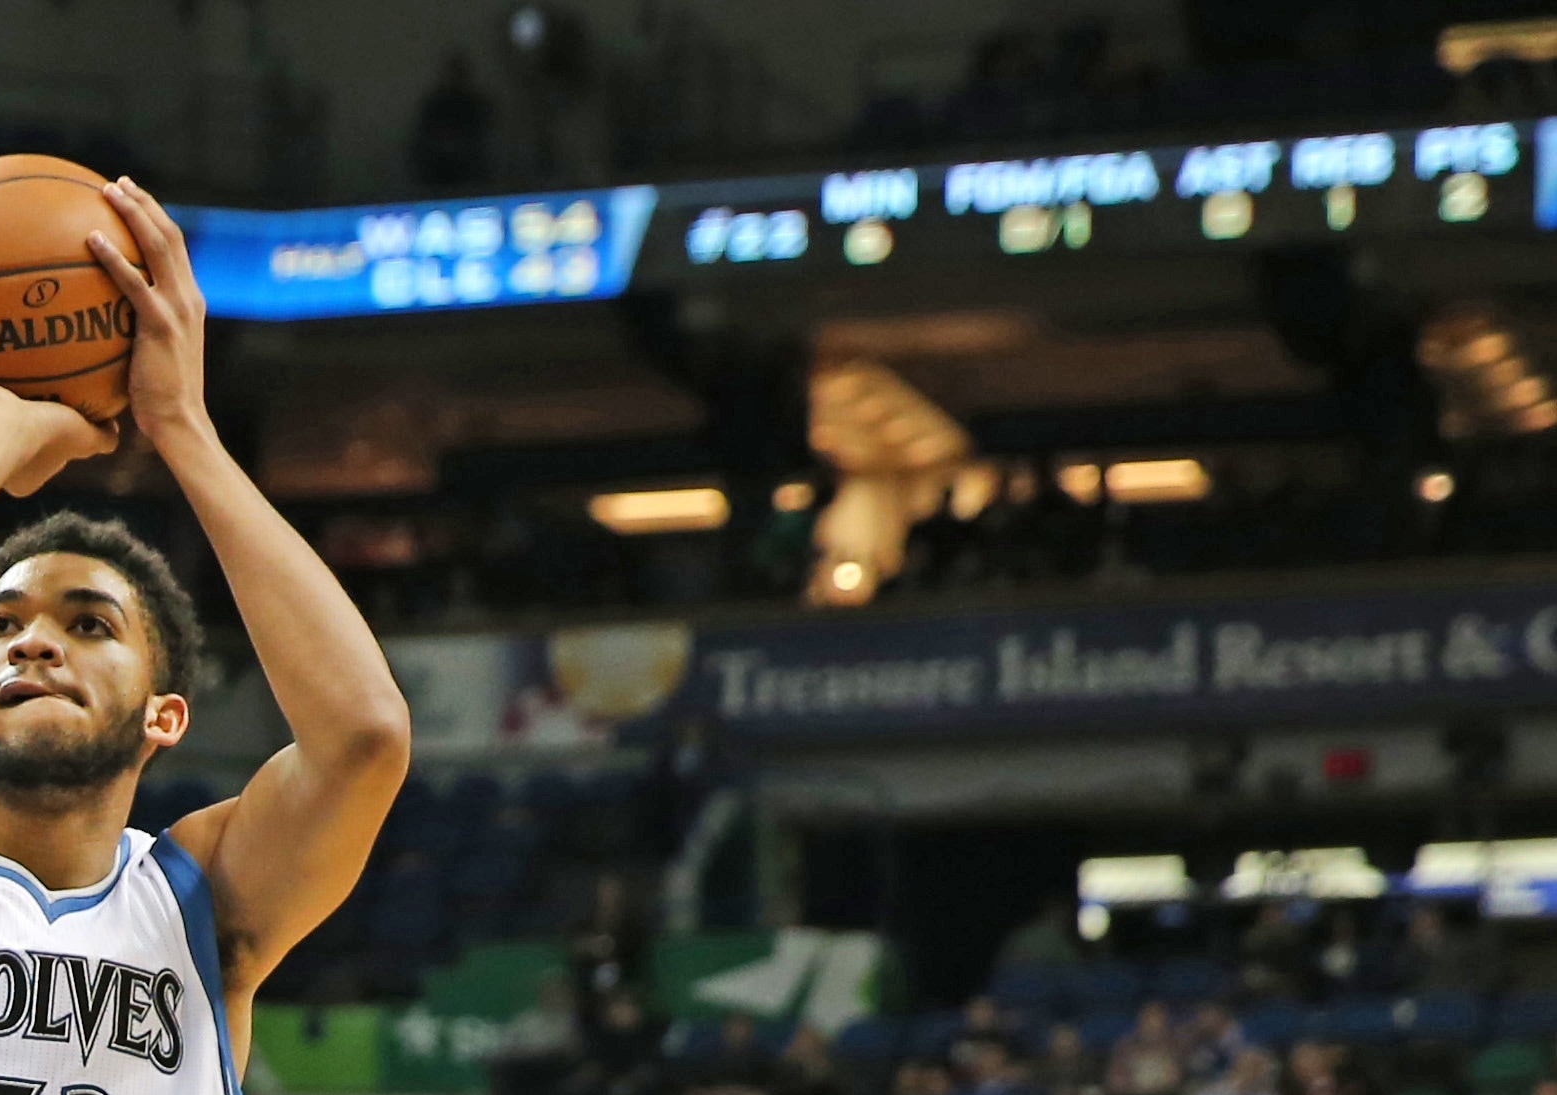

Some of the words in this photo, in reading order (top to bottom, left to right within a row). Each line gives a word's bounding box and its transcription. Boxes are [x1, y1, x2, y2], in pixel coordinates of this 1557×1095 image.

[703, 648, 983, 721] Treasure
[996, 620, 1200, 704] Island
[1211, 619, 1435, 696] Resort
[1440, 611, 1508, 681] &
